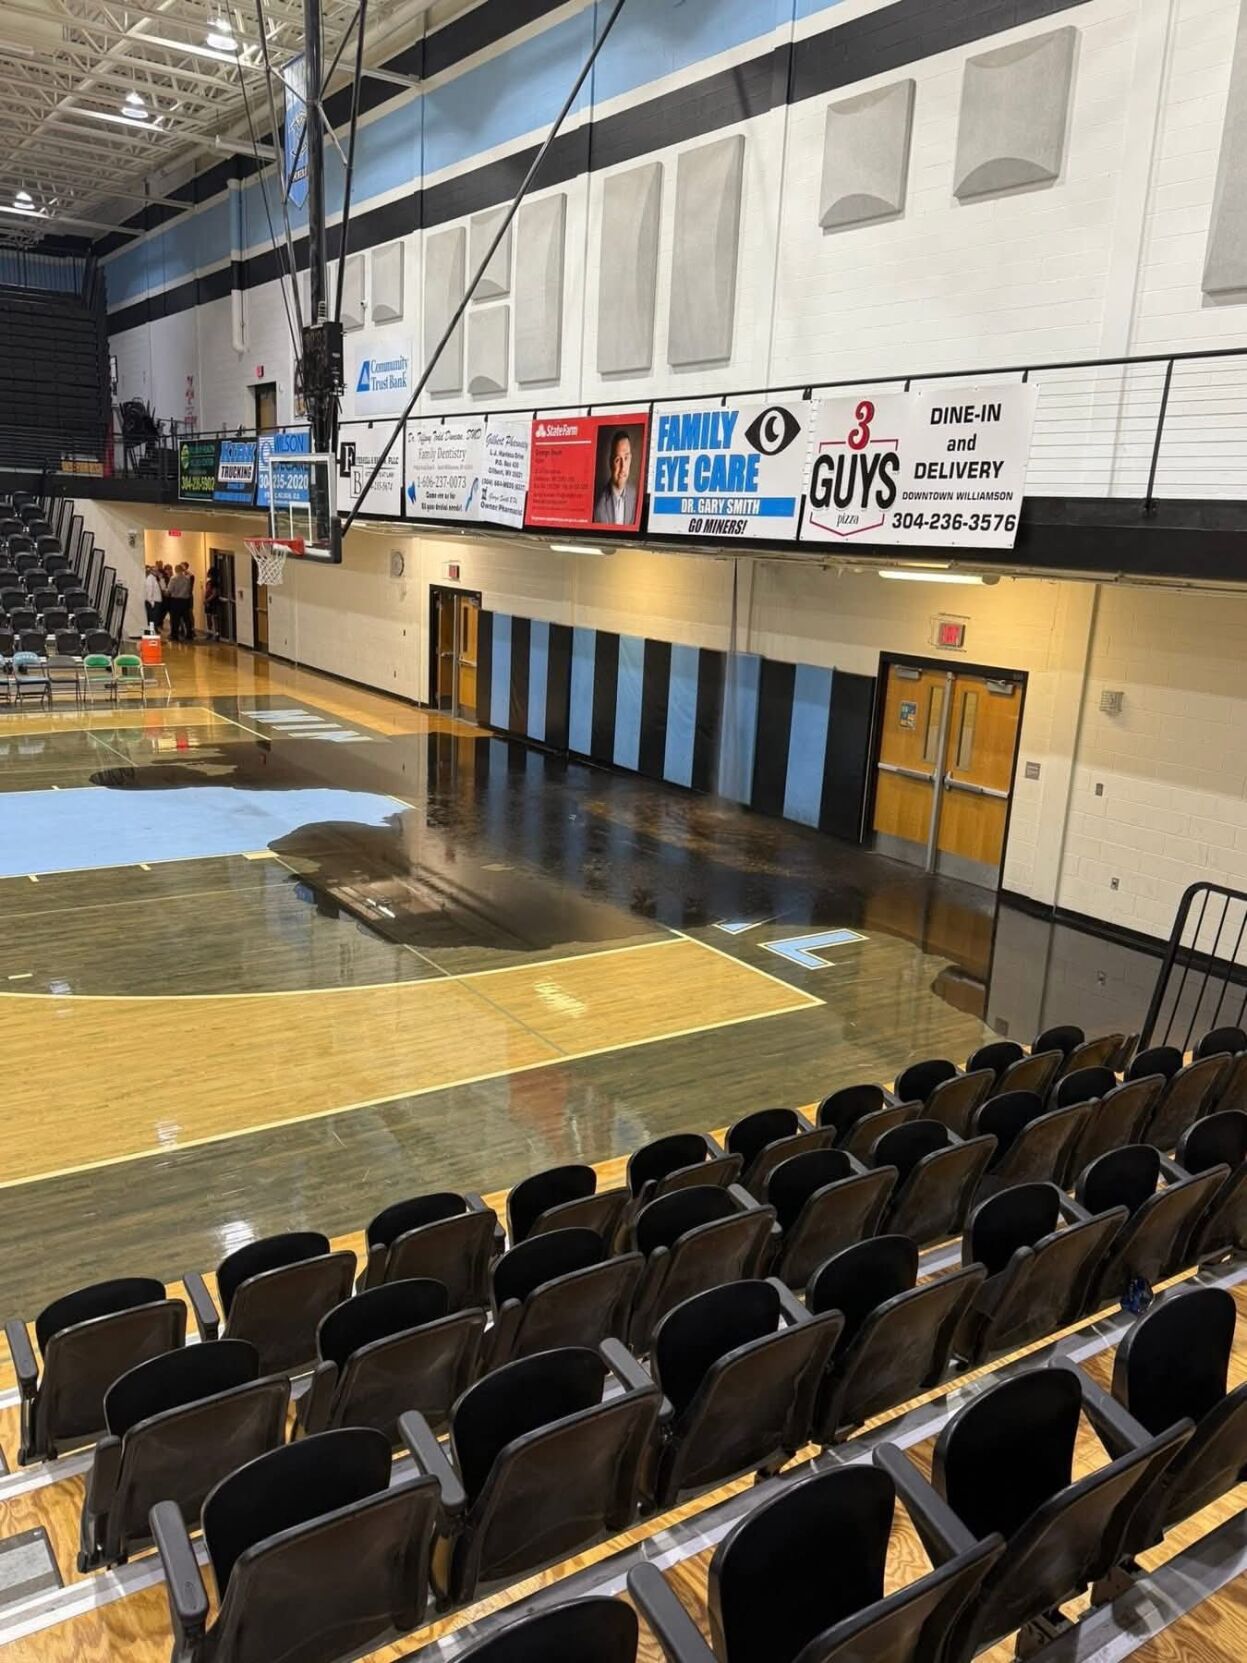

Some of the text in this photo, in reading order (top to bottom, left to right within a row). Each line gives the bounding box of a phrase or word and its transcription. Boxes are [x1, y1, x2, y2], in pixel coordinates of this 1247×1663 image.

[370, 354, 408, 373] Community
[371, 371, 407, 391] Trust Bank
[930, 403, 1002, 425] DINE-IN
[657, 411, 740, 452] FAMILY
[848, 400, 875, 450] 3
[947, 433, 977, 452] and
[418, 446, 466, 462] Family Dentistry
[221, 465, 252, 480] TRUCKING
[655, 454, 761, 492] EYE CARE
[914, 461, 1004, 479] DELIVERY
[417, 475, 467, 489] 1-606-237-0073
[810, 452, 900, 509] GUYS
[902, 491, 1013, 501] DOWNTOWN WILLIAMSON
[480, 500, 498, 511] Owner
[681, 499, 760, 515] DR. GARY SMITH
[688, 518, 748, 535] GO MINERS!
[836, 513, 859, 527] pizza
[892, 512, 1016, 531] 304-236-3576
